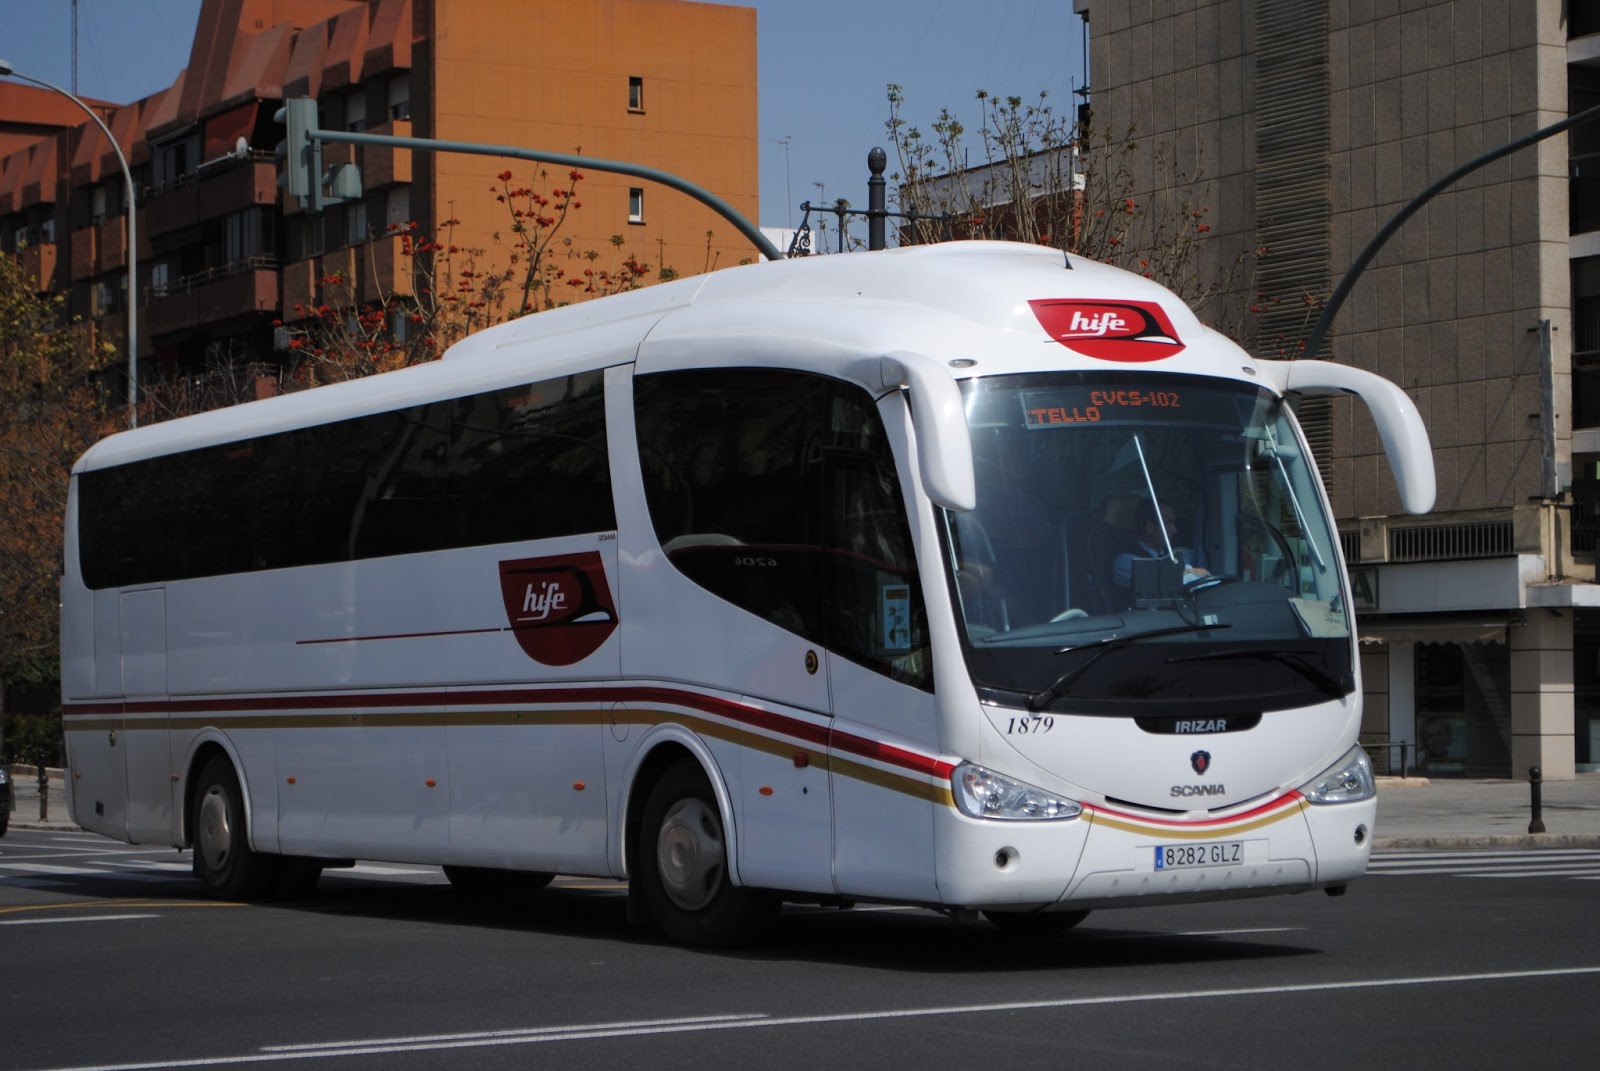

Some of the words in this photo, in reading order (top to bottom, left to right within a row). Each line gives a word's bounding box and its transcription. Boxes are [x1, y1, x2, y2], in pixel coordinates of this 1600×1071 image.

[1061, 311, 1130, 338] hife
[1090, 390, 1182, 408] CVCS-102
[1027, 406, 1101, 425] TELLO
[516, 581, 568, 621] hife
[1006, 716, 1055, 735] 1879
[1175, 719, 1227, 733] IRIZAR
[1169, 784, 1226, 798] SCANIA
[1166, 846, 1206, 866] 8282
[1211, 844, 1240, 863] GLZ
